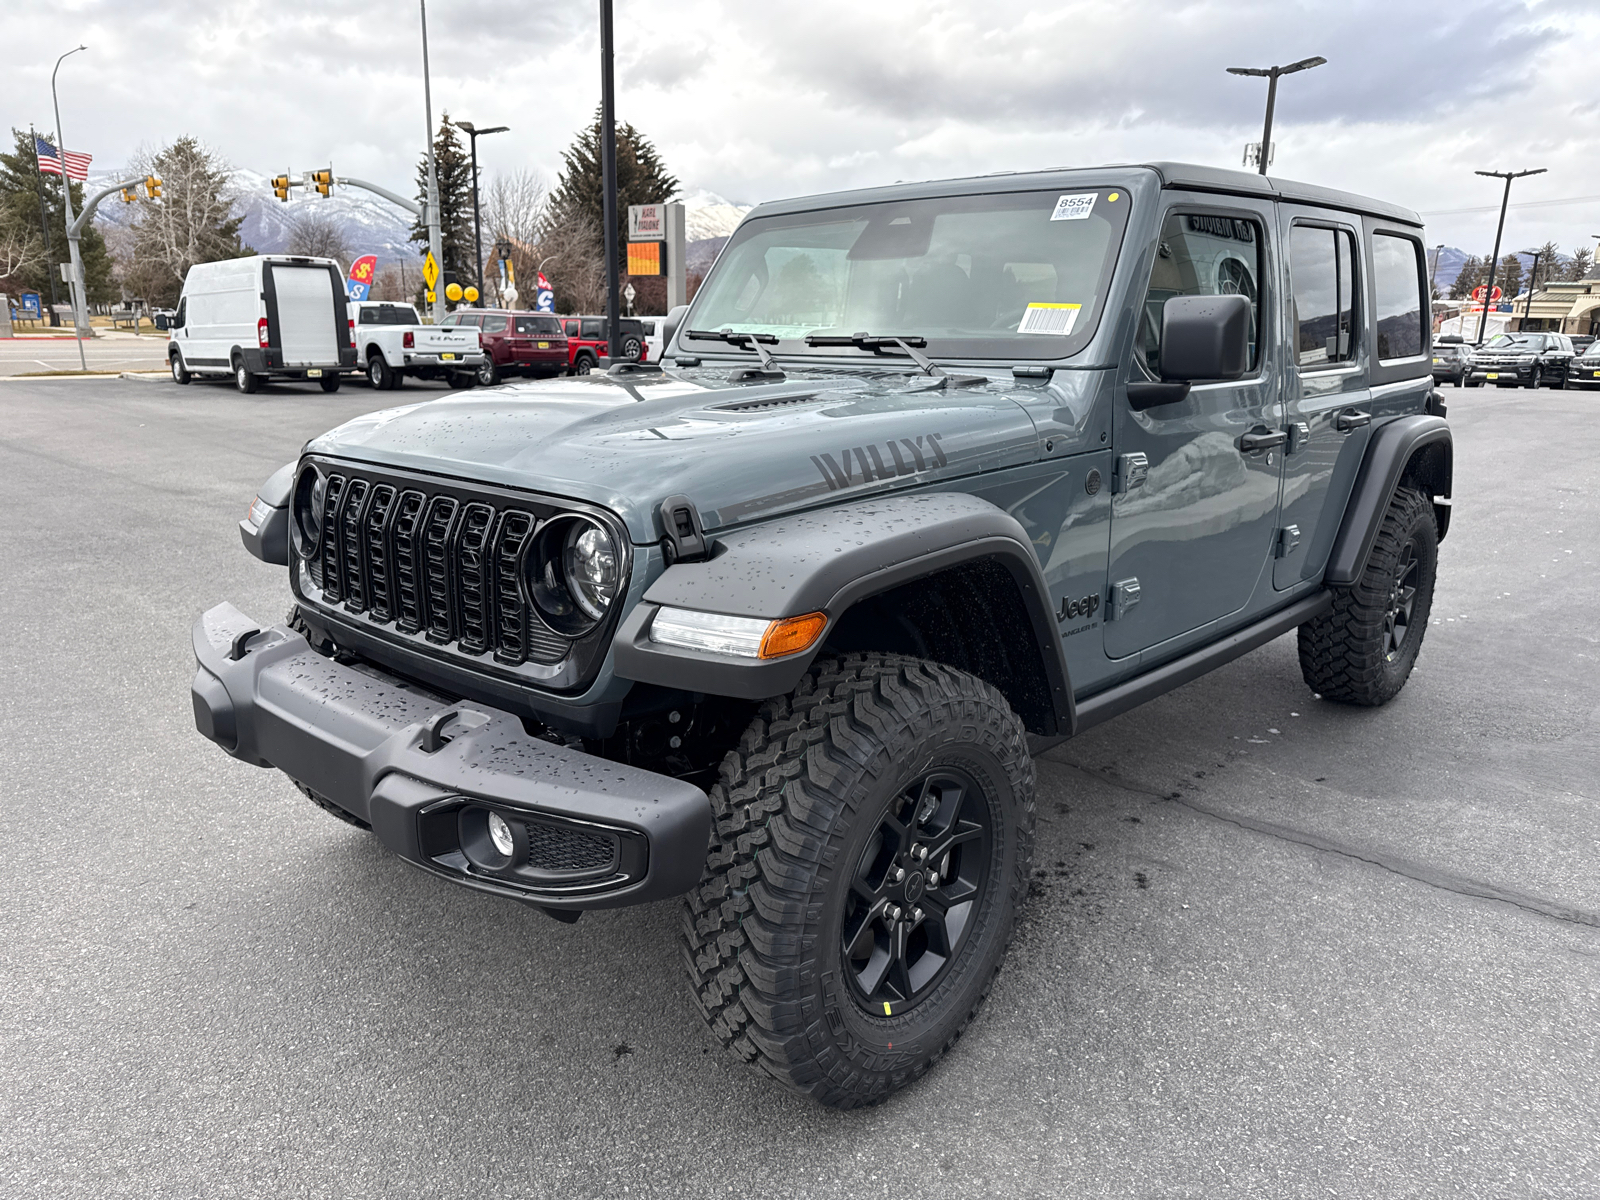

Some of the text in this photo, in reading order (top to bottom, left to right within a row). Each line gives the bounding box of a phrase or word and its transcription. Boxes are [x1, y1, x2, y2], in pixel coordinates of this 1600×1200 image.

[1060, 197, 1093, 207] 8554
[809, 432, 948, 491] WILLYS
[1056, 592, 1100, 624] Jeep
